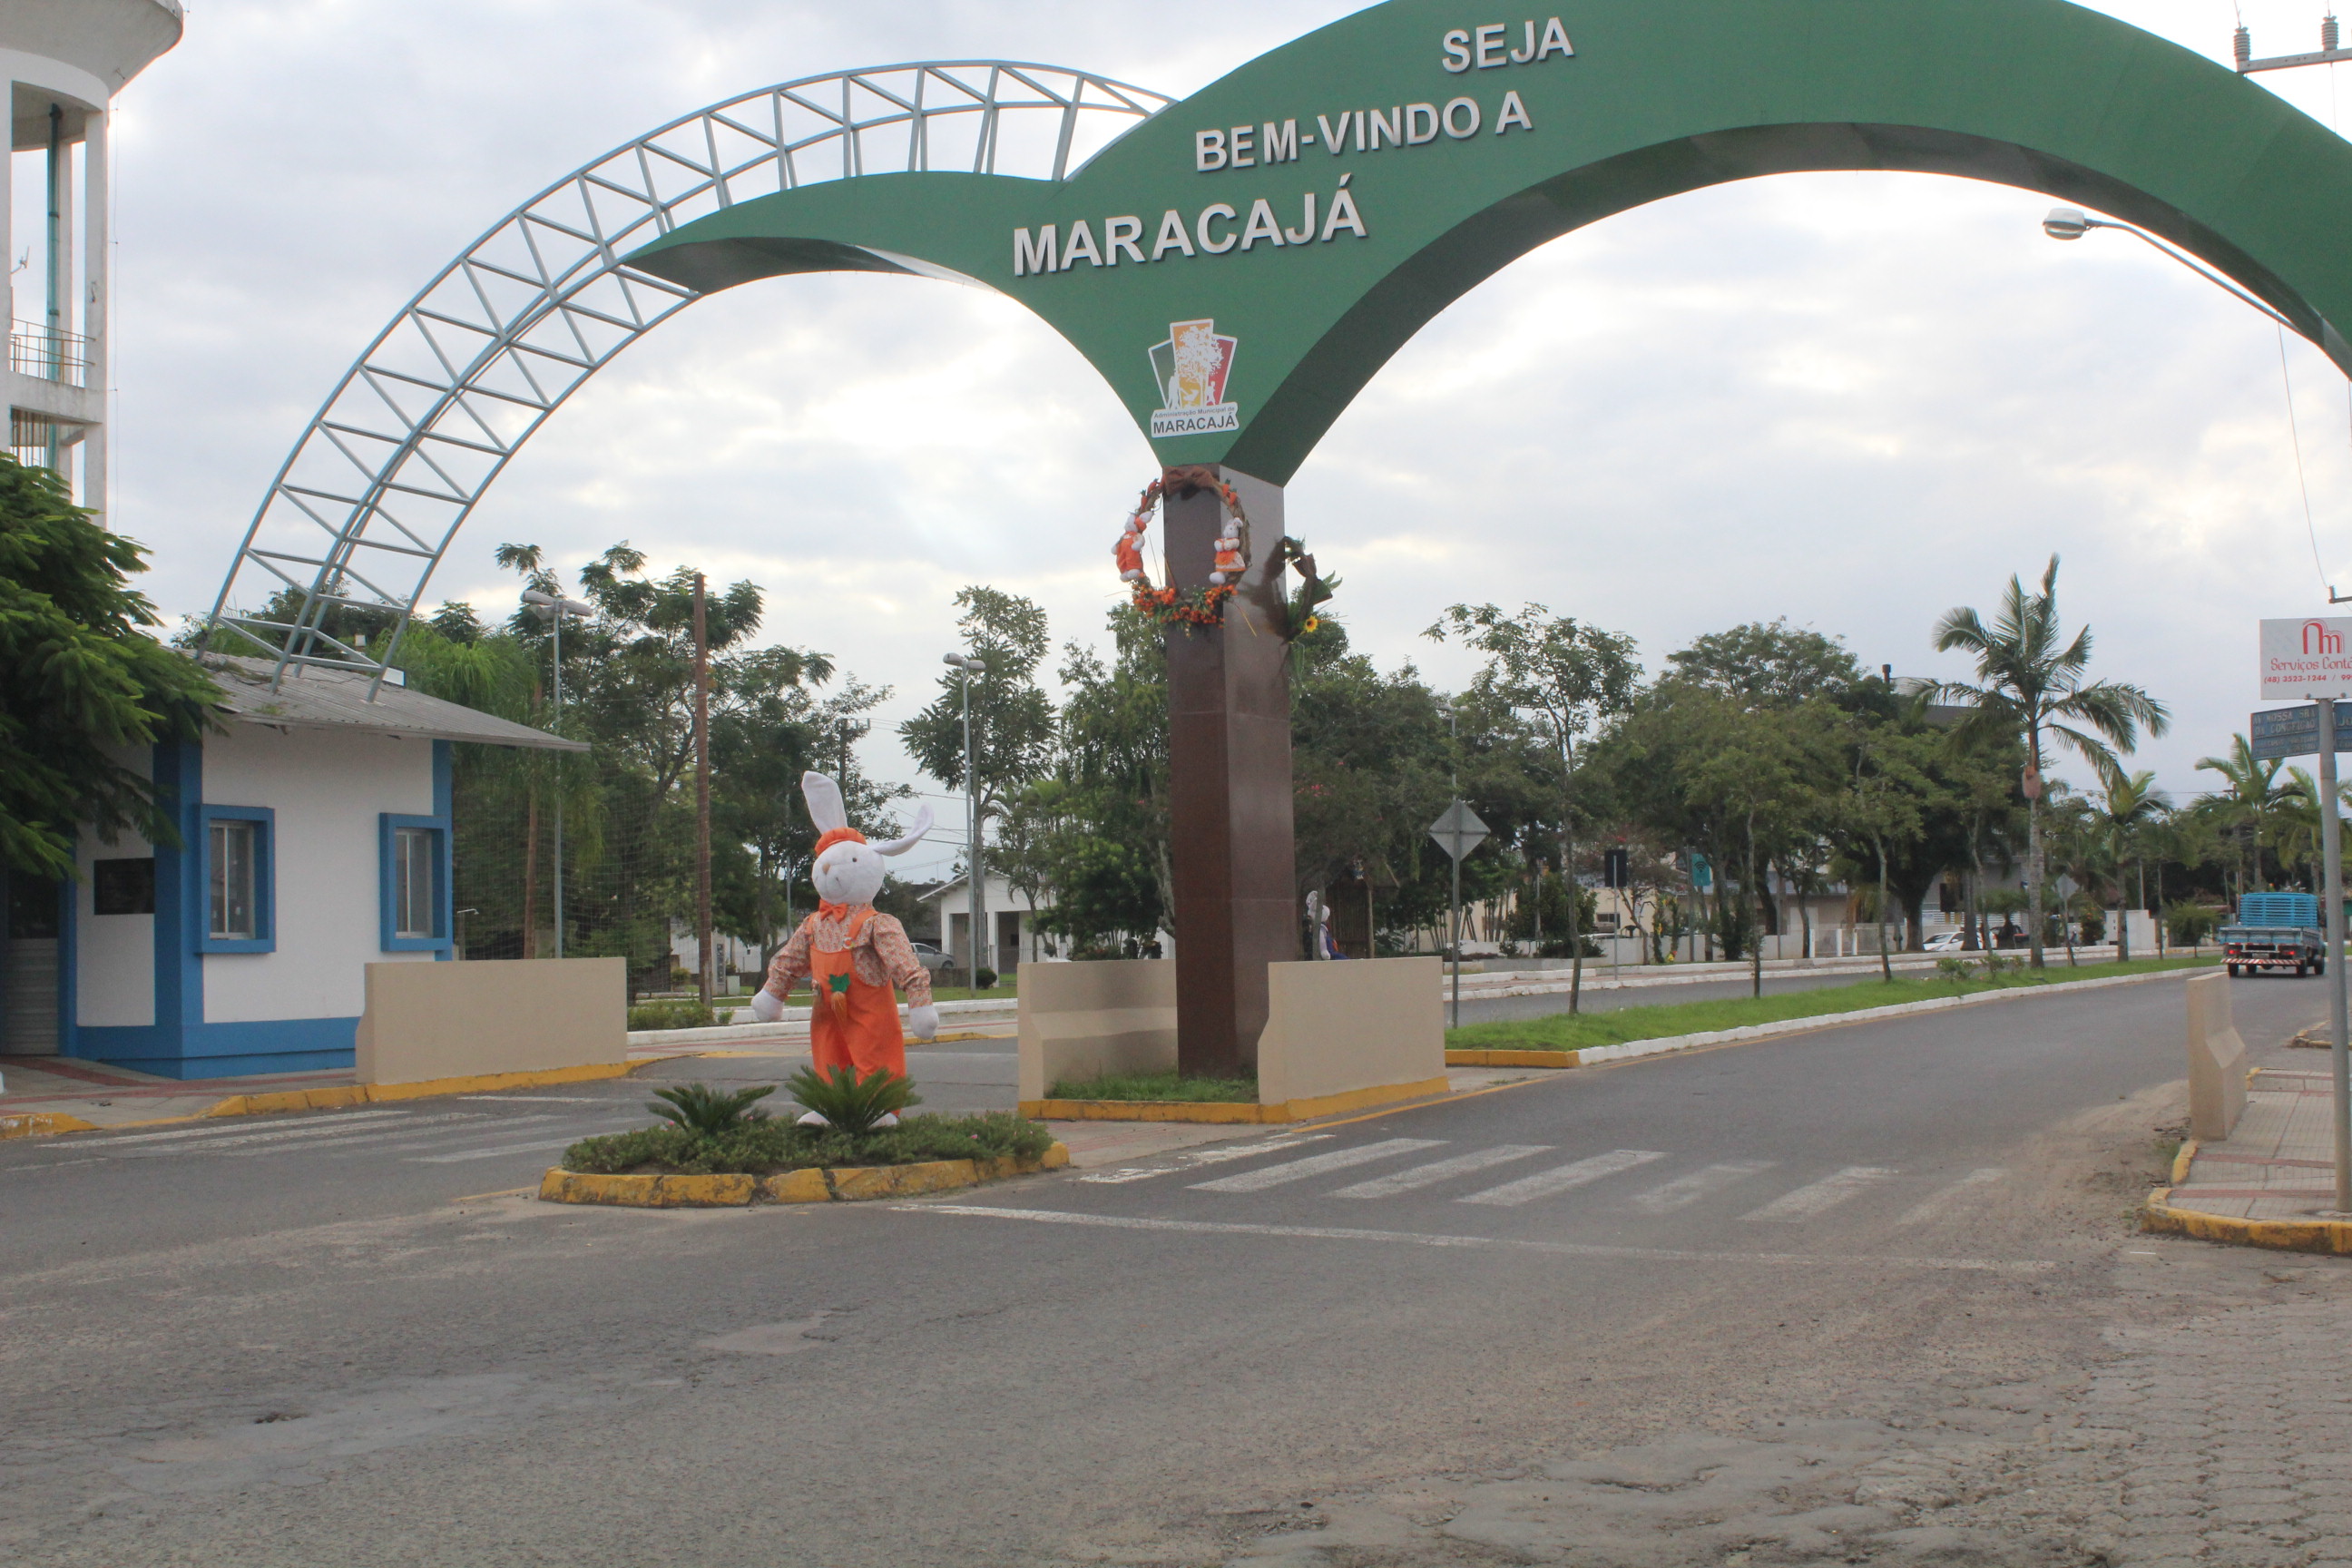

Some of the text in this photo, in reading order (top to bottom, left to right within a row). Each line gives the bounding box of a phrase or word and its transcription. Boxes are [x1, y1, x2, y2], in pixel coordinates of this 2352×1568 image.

[1441, 16, 1574, 74] SEJA
[1195, 90, 1533, 172] BEM-VINDO A
[1013, 172, 1367, 278] MARACAJÁ
[1154, 409, 1196, 419] Administração
[1198, 406, 1226, 415] Municipal
[1153, 412, 1236, 434] MARACAJÁ
[2270, 656, 2319, 672] Serviços
[2264, 674, 2280, 684] (48)
[2282, 674, 2327, 682] 3523-1244
[2266, 711, 2293, 722] NOSSA
